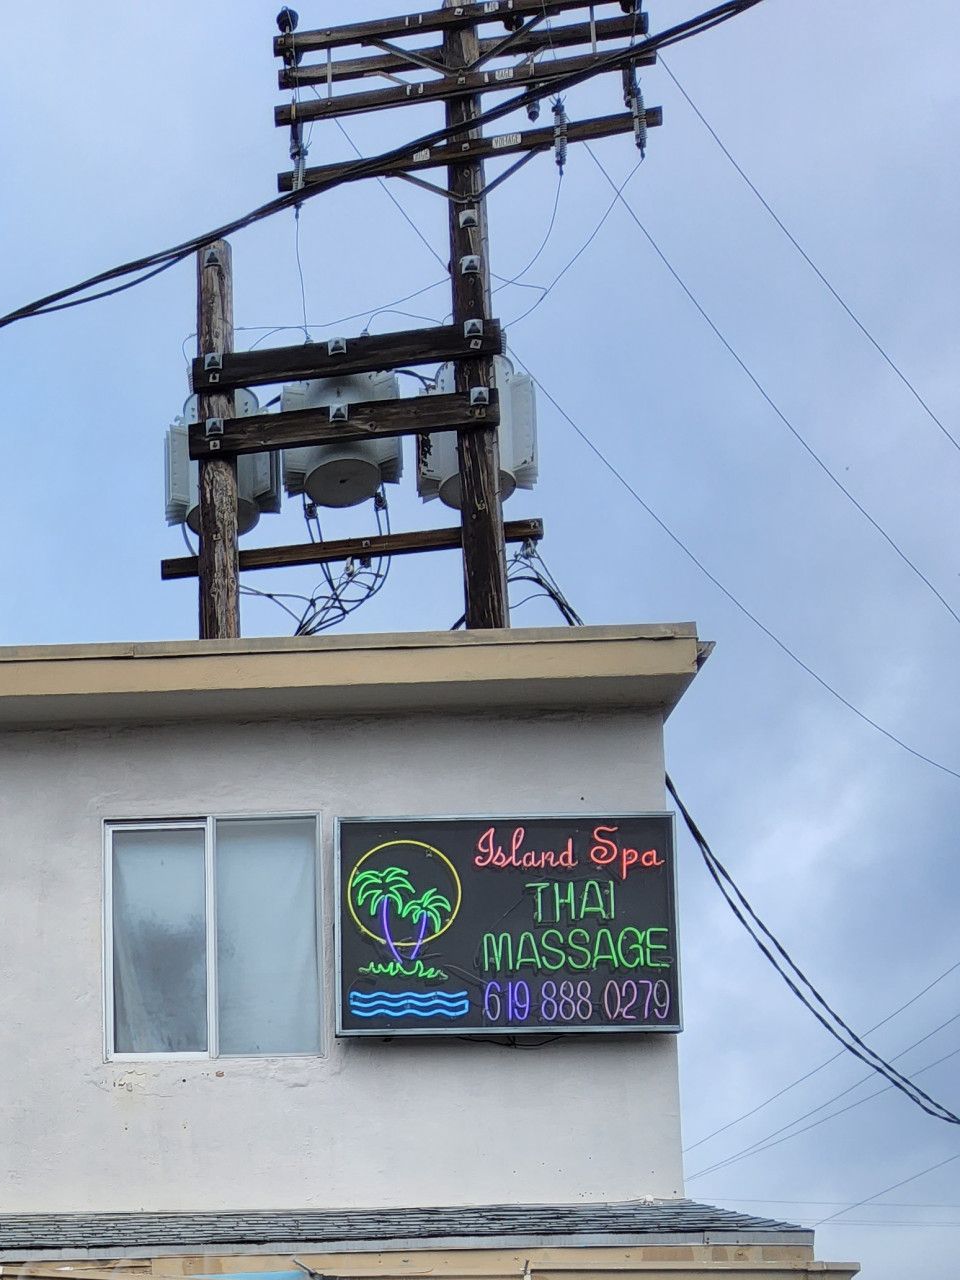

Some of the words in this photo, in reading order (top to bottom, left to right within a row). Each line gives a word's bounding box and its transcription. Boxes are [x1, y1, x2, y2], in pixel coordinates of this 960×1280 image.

[475, 827, 578, 868] Island
[590, 826, 665, 880] Spa
[526, 881, 615, 923] THAI
[483, 927, 671, 971] MASSAGE
[485, 981, 530, 1021] 619
[541, 980, 593, 1021] 888
[604, 979, 670, 1021] 0279
